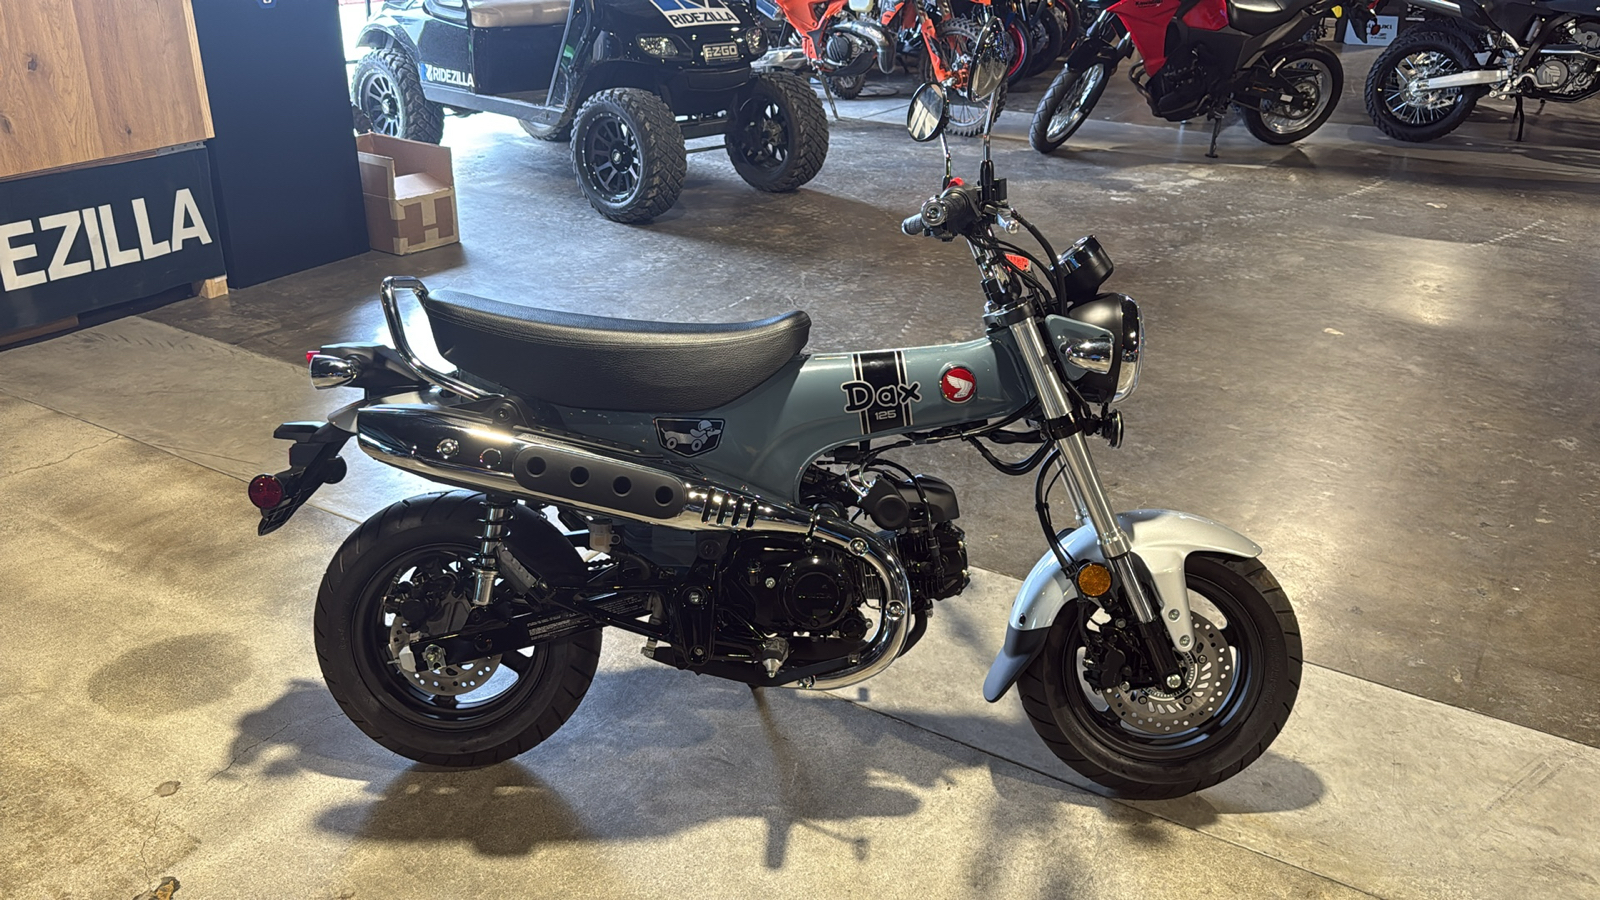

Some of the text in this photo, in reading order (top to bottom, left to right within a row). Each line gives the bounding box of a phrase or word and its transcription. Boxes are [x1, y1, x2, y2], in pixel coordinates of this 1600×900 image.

[668, 11, 737, 26] RIDEZILLA
[432, 66, 475, 88] RIDEZILLA
[0, 187, 213, 292] EZILLA
[840, 380, 922, 413] Dax
[874, 409, 897, 420] 125
